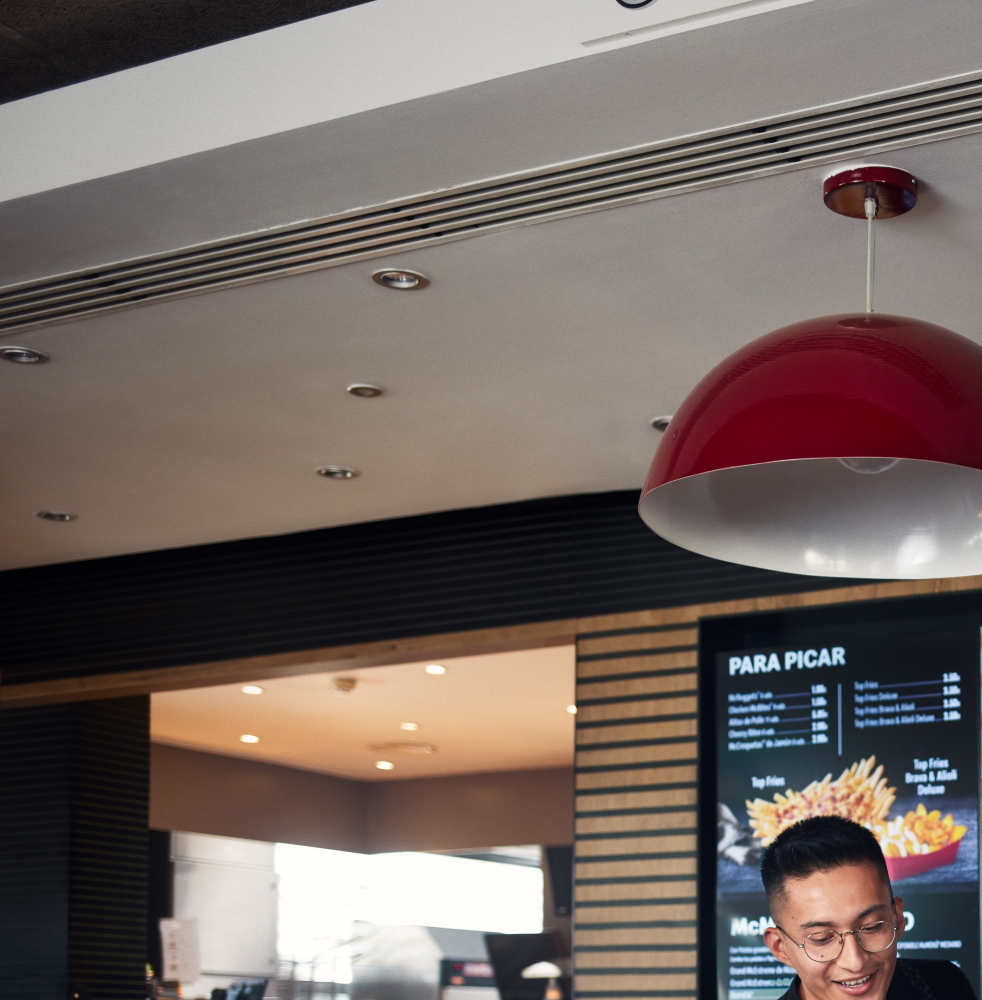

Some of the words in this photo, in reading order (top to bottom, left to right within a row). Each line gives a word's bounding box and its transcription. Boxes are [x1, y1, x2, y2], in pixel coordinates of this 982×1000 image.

[729, 653, 781, 676] PARA
[784, 646, 846, 671] PICAR
[913, 758, 928, 771] Top
[928, 757, 949, 770] Fries
[751, 776, 765, 790] Top
[765, 775, 785, 788] Fries
